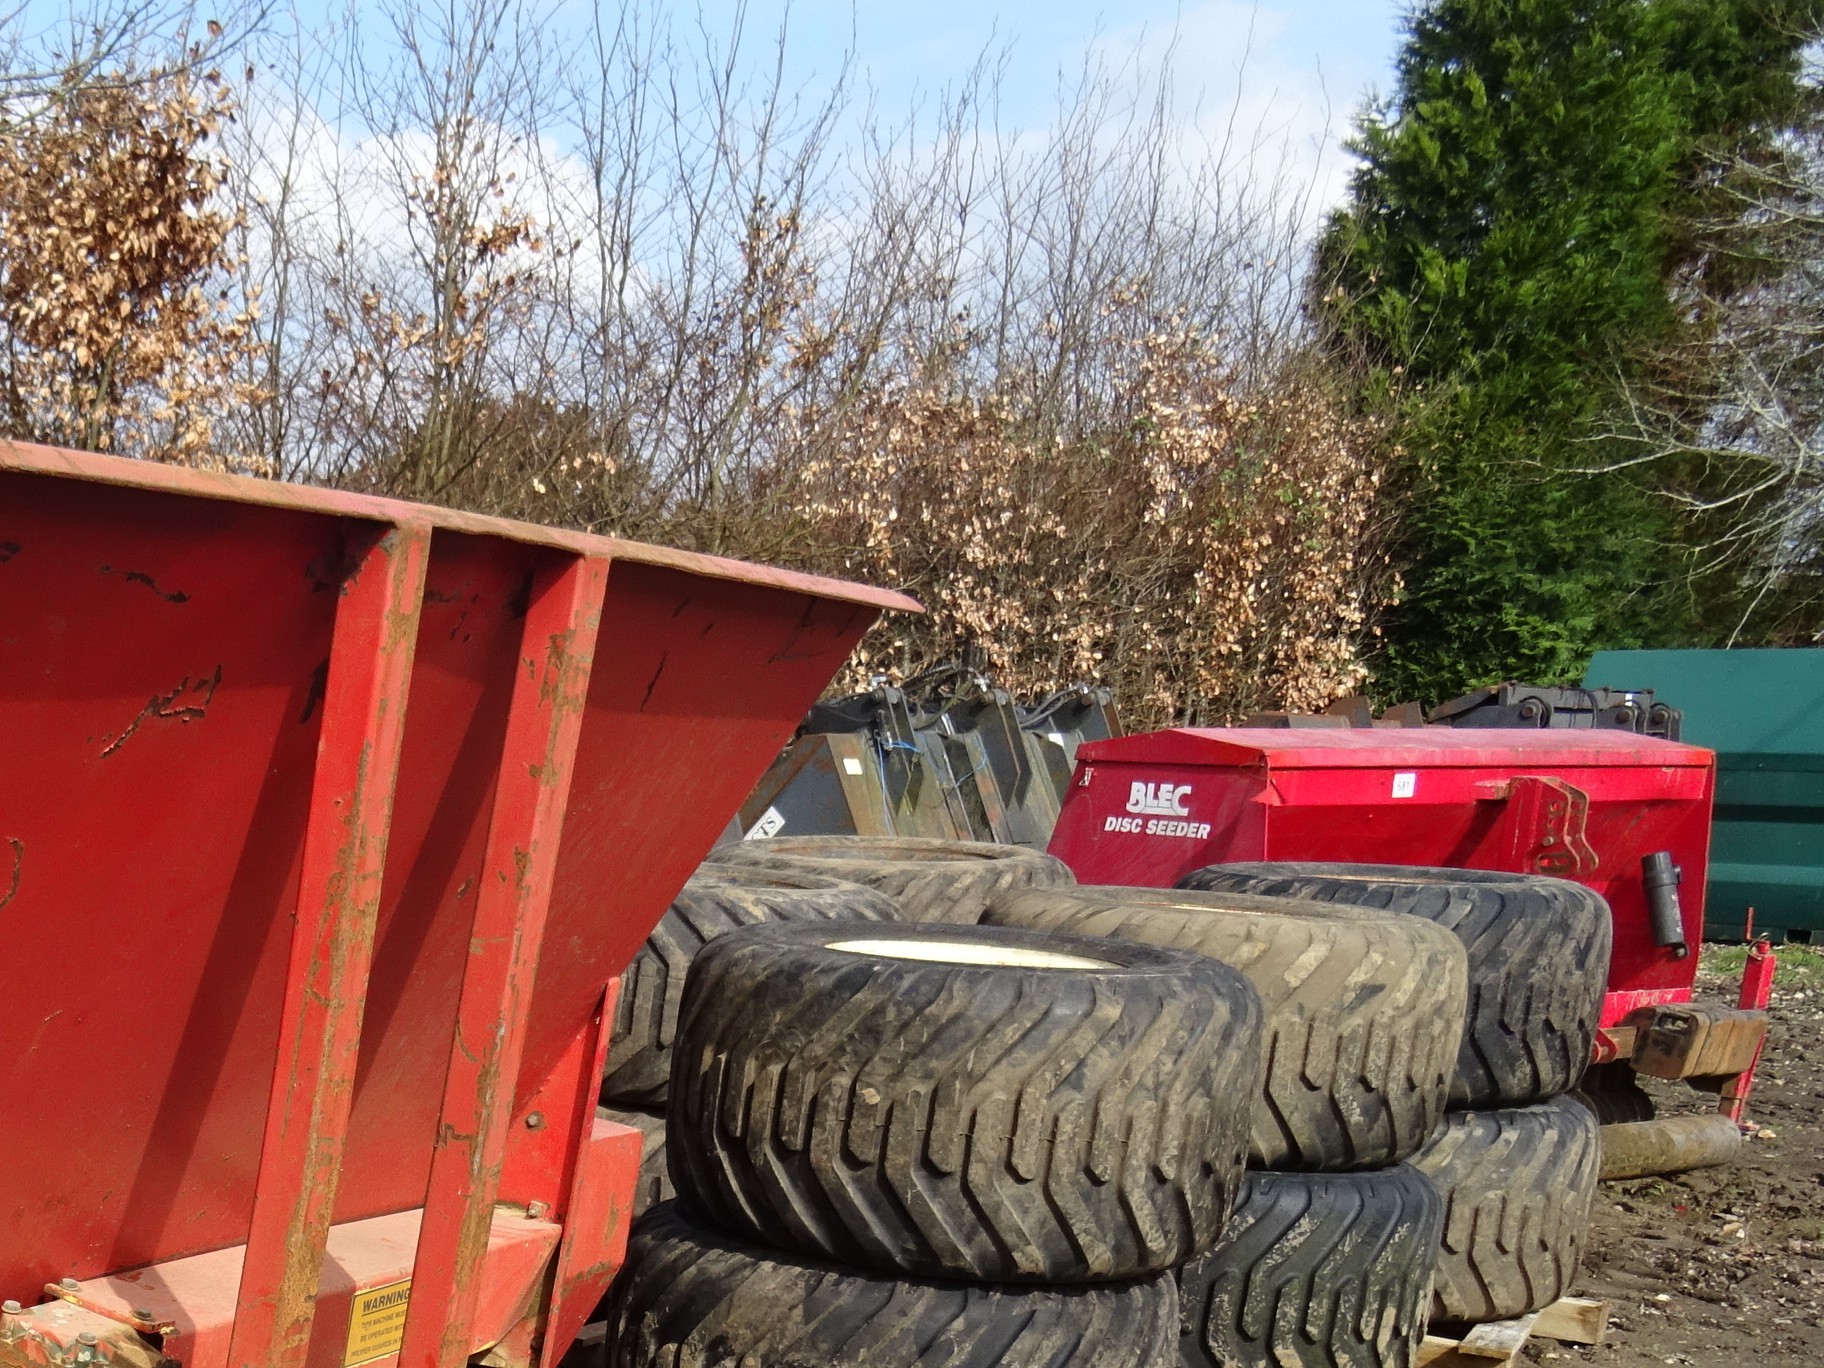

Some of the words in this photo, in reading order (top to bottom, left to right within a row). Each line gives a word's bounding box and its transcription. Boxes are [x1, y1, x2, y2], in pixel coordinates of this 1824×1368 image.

[1125, 781, 1193, 817] BLEC
[1104, 816, 1144, 834] DISC
[1145, 819, 1212, 840] SEEDER
